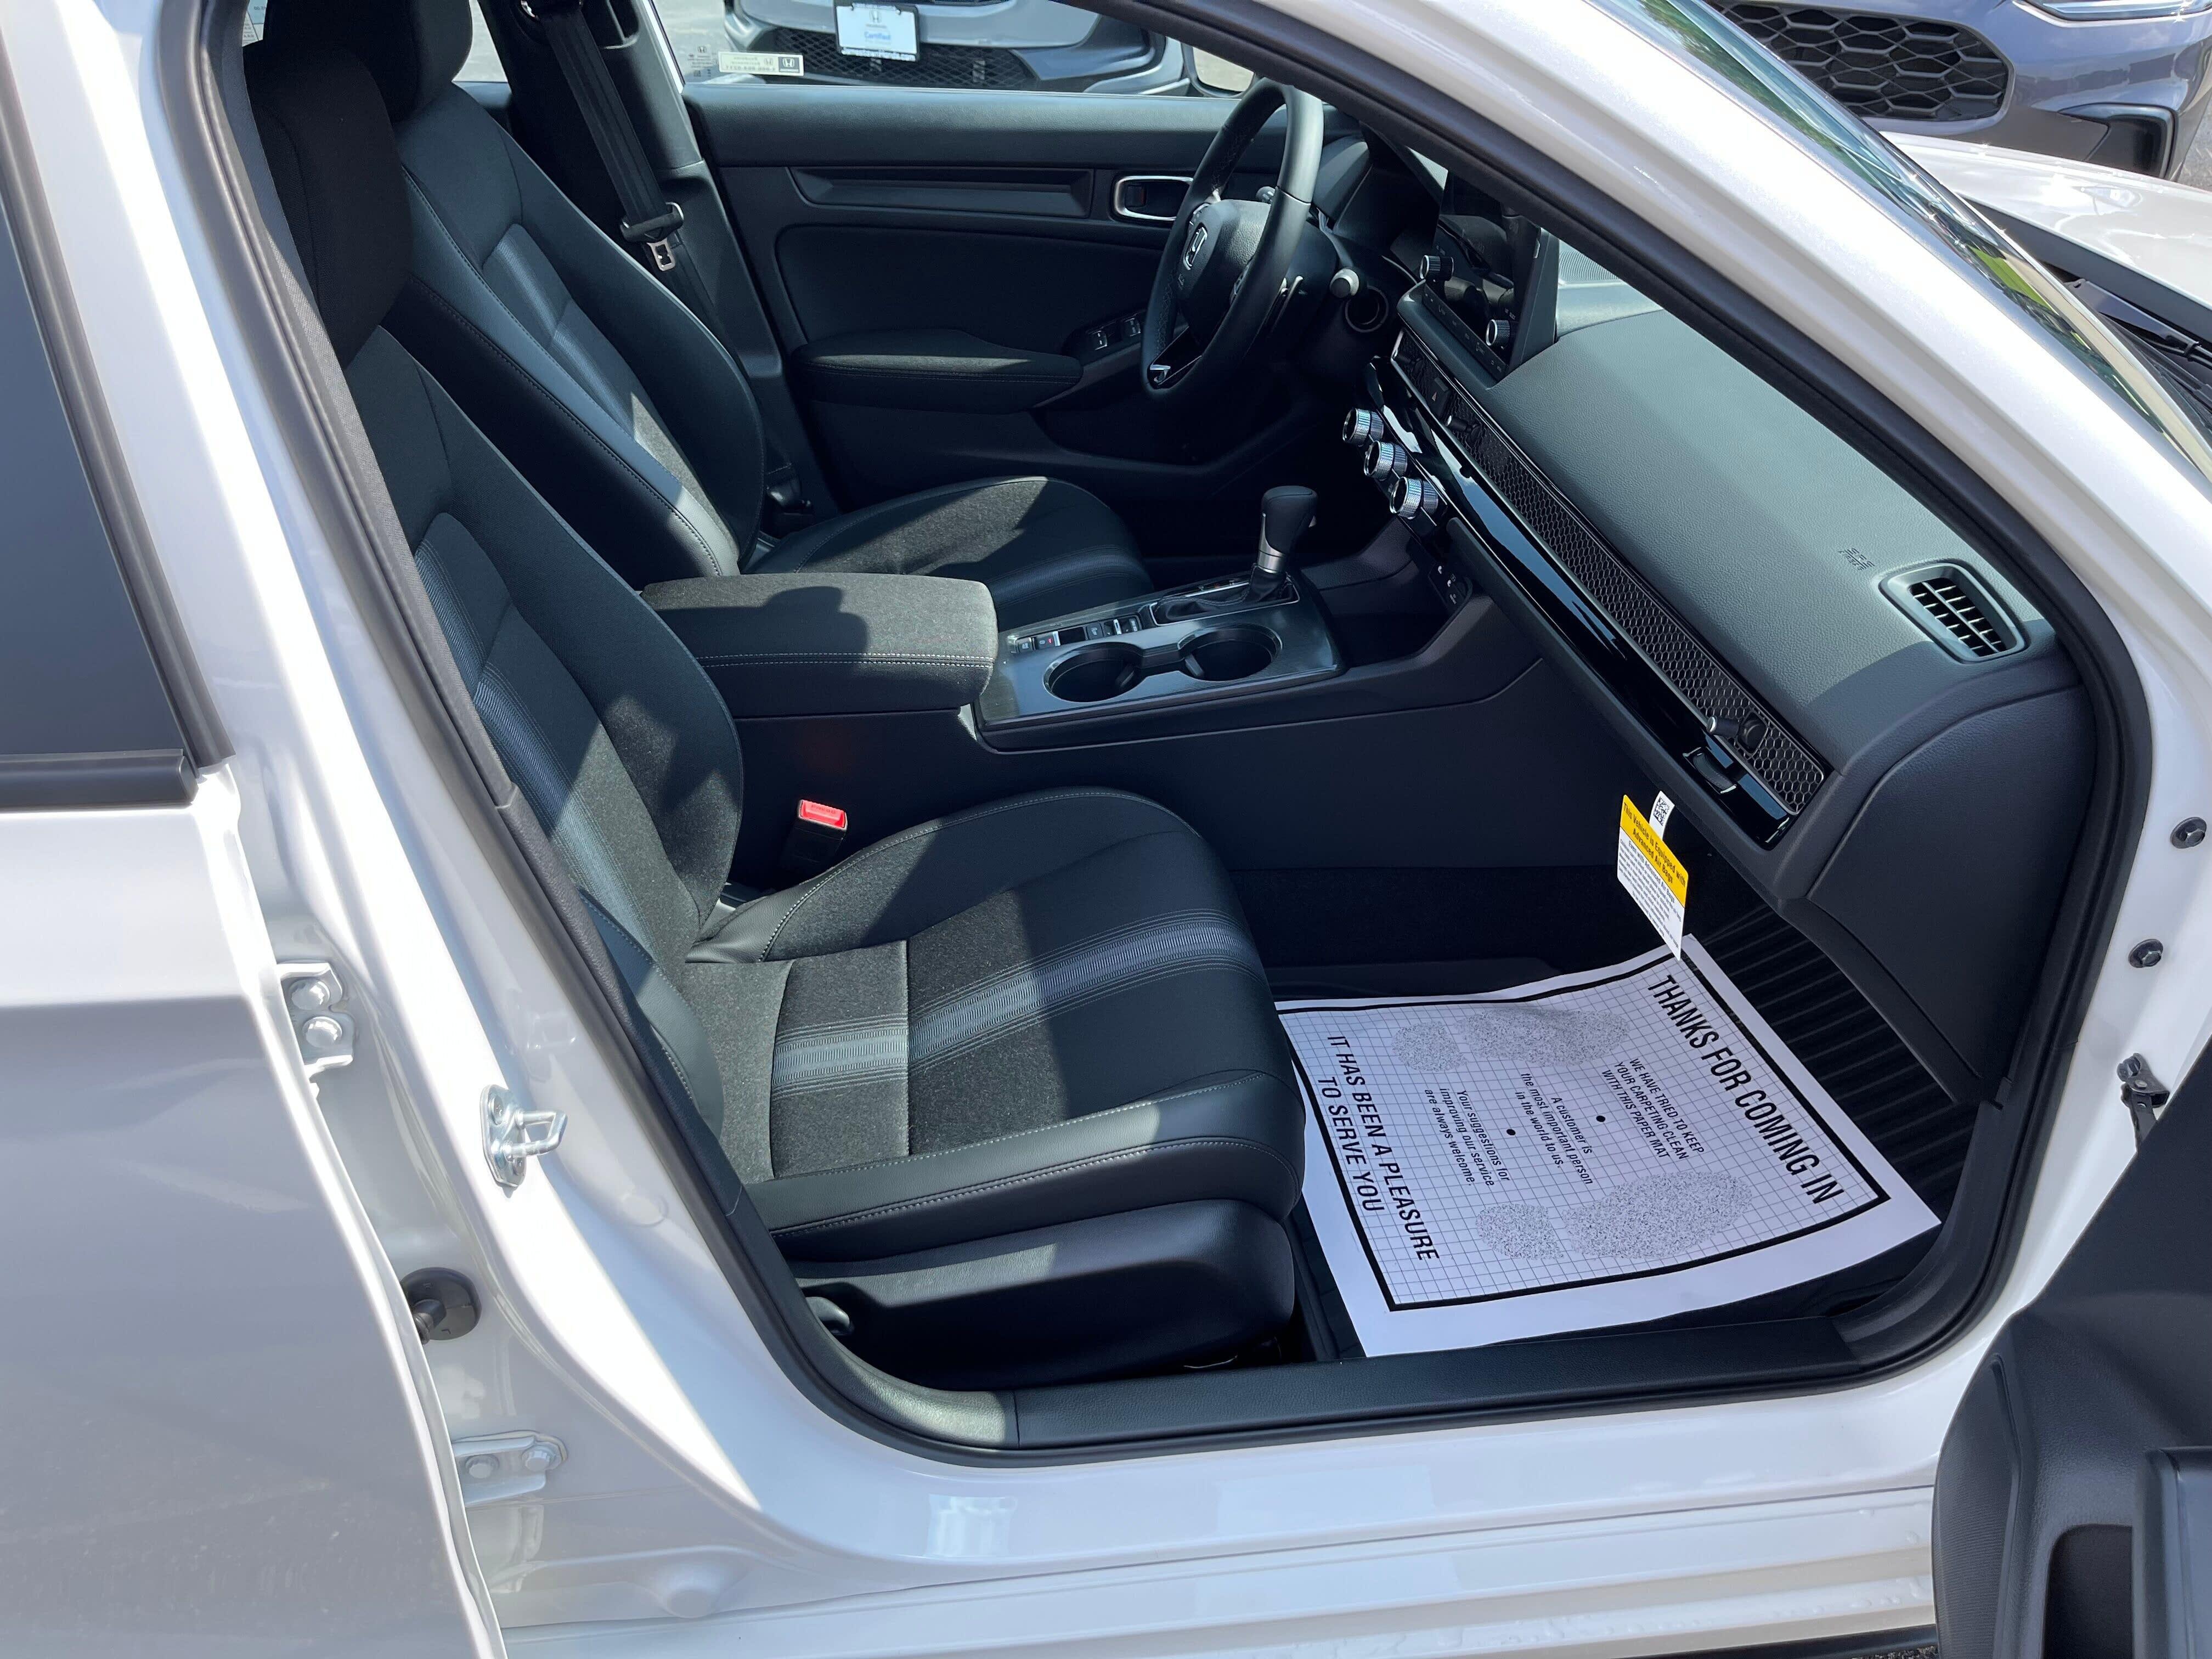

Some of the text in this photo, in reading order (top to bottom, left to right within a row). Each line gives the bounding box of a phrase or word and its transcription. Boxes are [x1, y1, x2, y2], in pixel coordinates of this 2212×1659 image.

[1623, 802, 1686, 888] This Vehicle is Equipped with
[1633, 828, 1654, 859] Advanced
[1662, 865, 1673, 883] Bags
[1457, 1090, 1510, 1181] Your suggestions for
[1521, 1073, 1593, 1184] the most important person
[1521, 1102, 1534, 1115] the
[1530, 1118, 1553, 1141] world
[1545, 1143, 1556, 1152] to
[1551, 1154, 1564, 1168] us.
[1556, 1105, 1587, 1143] customer
[1582, 1146, 1592, 1154] is
[1601, 1069, 1671, 1158] WITH THIS PAPER MAT
[1615, 1062, 1689, 1159] YOUR CARPETING CLEAN
[1629, 1058, 1705, 1153] WE HAVE TRIED TO KEEP
[1647, 974, 1719, 1048] THANKS
[1701, 1047, 1751, 1091] FOR
[1735, 1090, 1820, 1176] COMING
[1801, 1174, 1844, 1204] IN
[1318, 1076, 1385, 1211] TO SERVE YOU
[1328, 1036, 1440, 1260] IT HAS BEEN A PLEASURE
[1425, 1090, 1475, 1186] are always welcome.
[1440, 1088, 1494, 1186] improving our service
